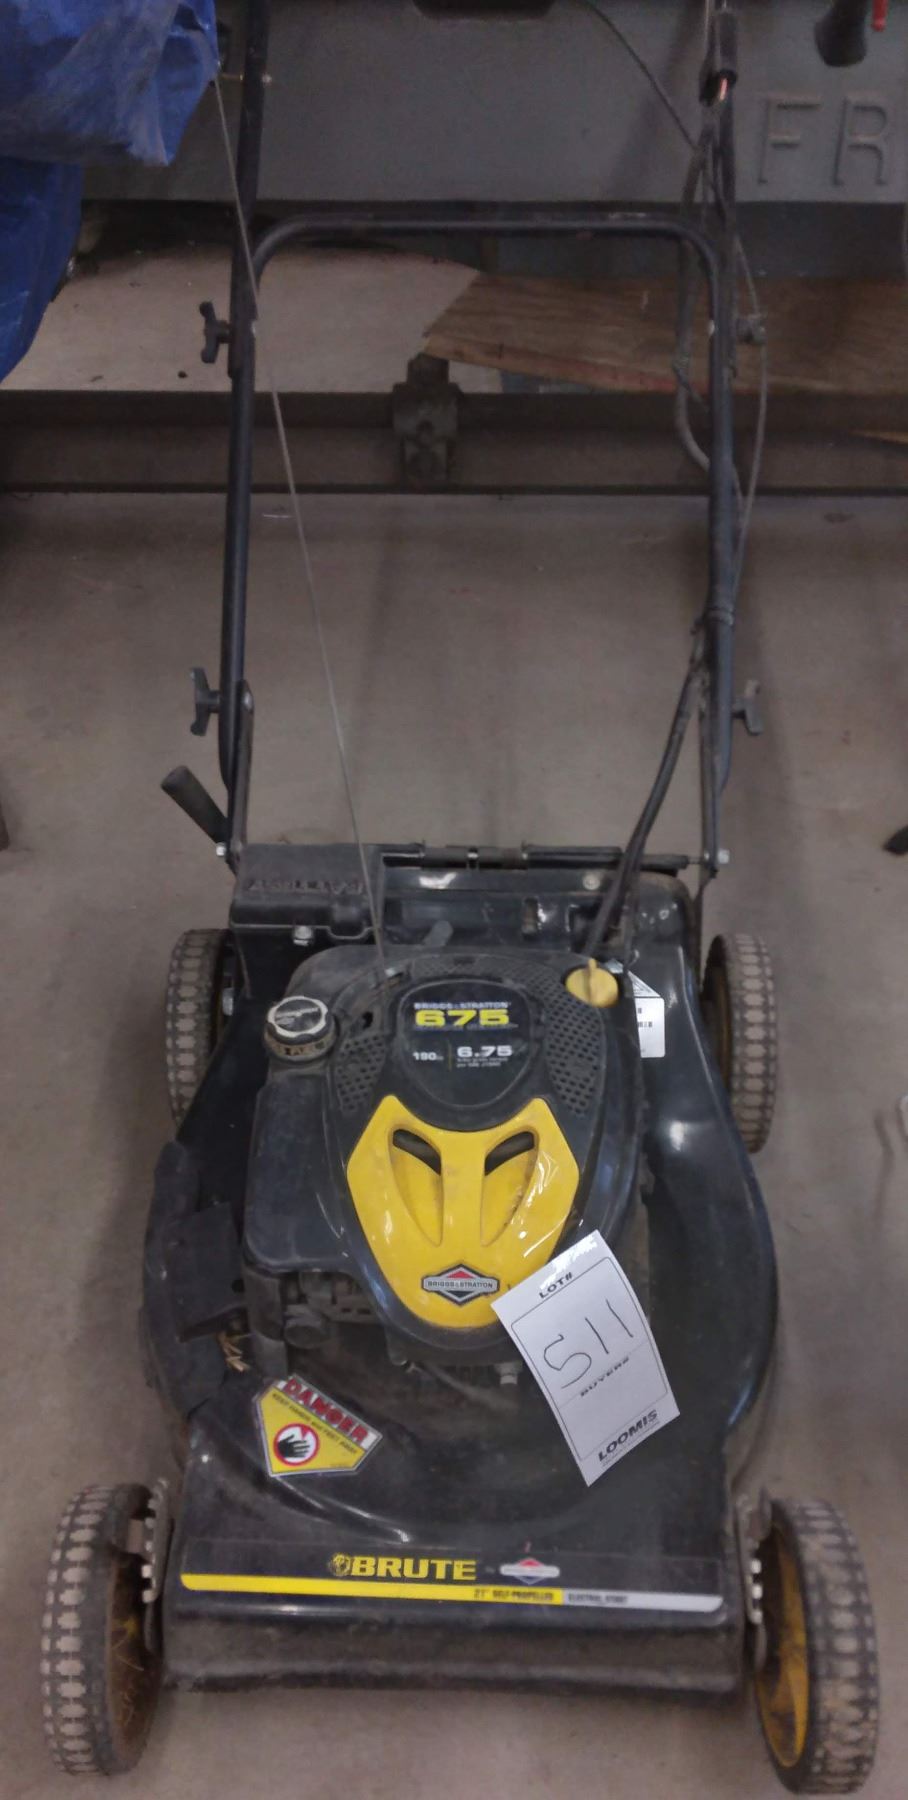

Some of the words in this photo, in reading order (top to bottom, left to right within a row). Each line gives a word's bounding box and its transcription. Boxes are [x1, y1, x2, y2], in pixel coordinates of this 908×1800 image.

[415, 1008, 510, 1027] 675
[456, 1044, 513, 1059] 6.75
[539, 1271, 573, 1299] LOT#
[283, 1378, 369, 1442] DANGER
[598, 1409, 658, 1462] LOOMIS
[351, 1556, 477, 1581] BRUTE
